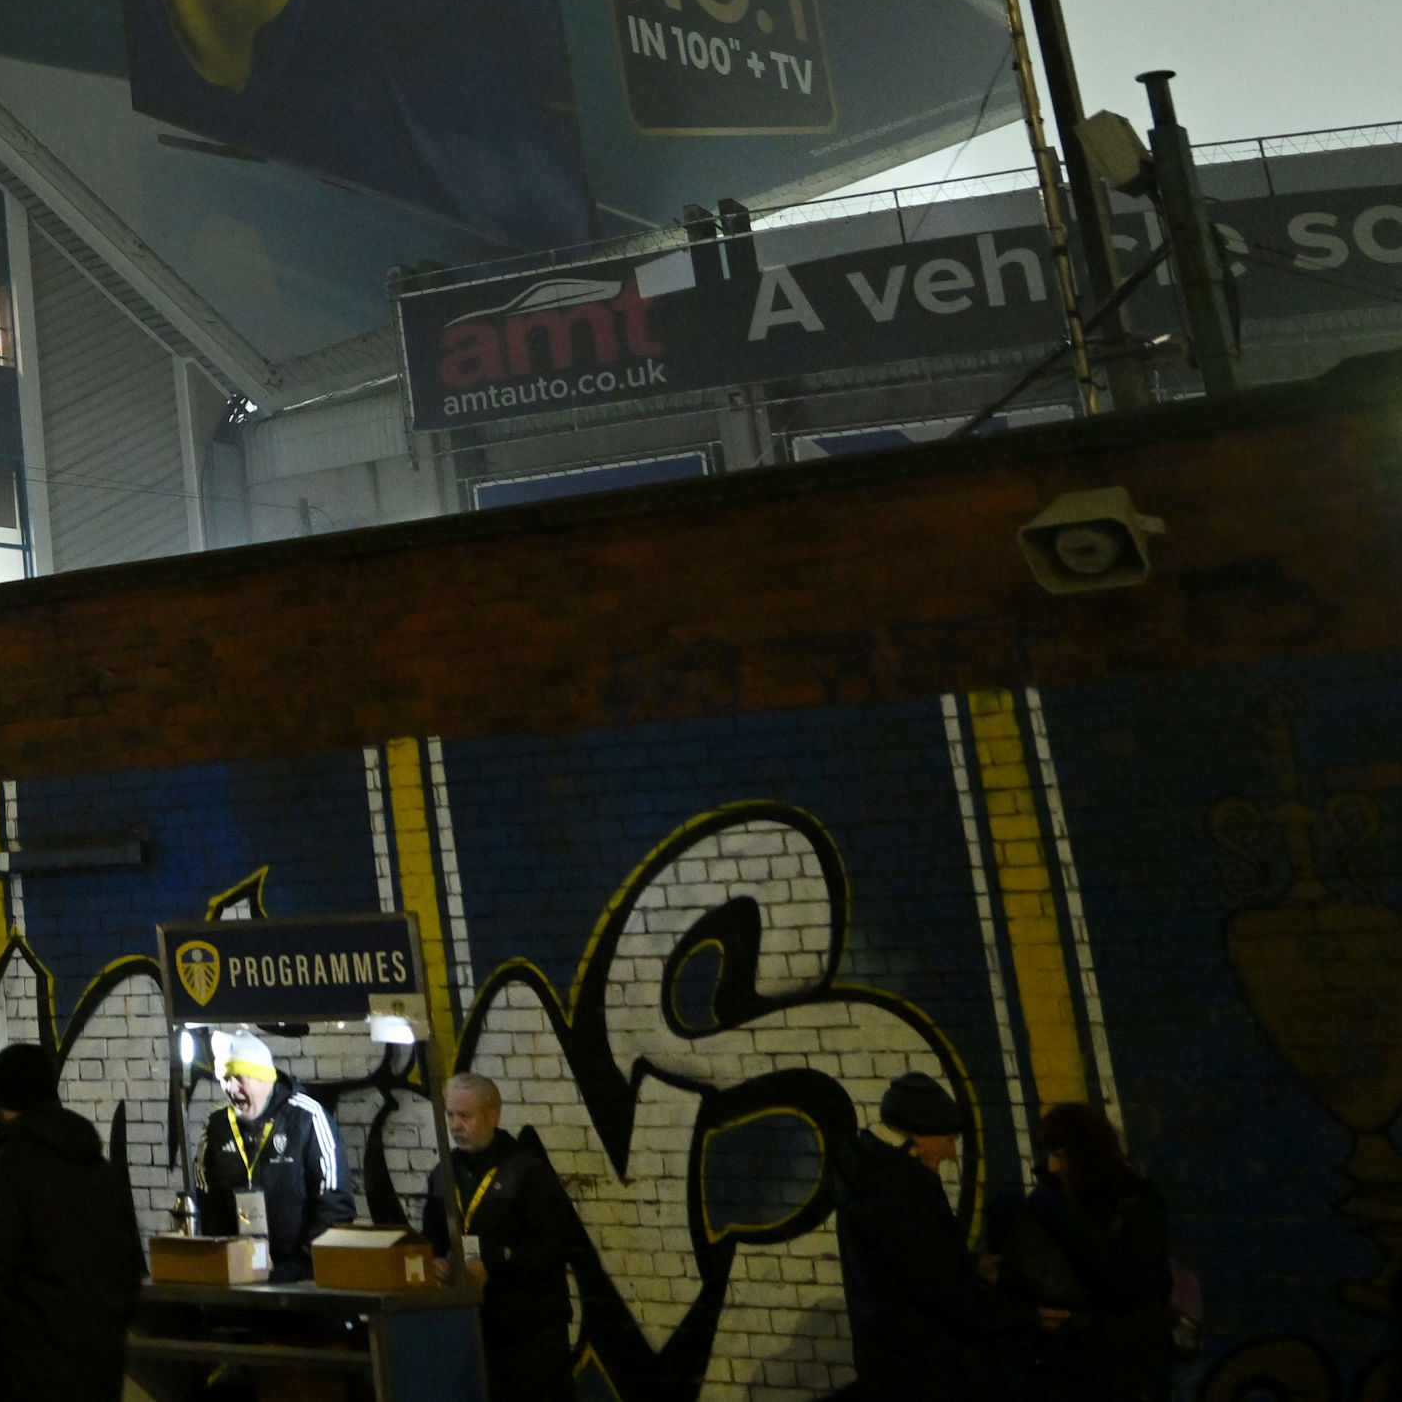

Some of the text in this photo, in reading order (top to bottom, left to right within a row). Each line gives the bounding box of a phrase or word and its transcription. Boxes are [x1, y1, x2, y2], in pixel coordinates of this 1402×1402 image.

[627, 14, 667, 61] IN
[769, 50, 813, 95] TV
[746, 263, 825, 342] A
[846, 210, 1249, 324] vehl
[439, 278, 666, 391] amt
[443, 358, 668, 416] amtauto.co.uk
[227, 950, 408, 989] PROGRAMMES
